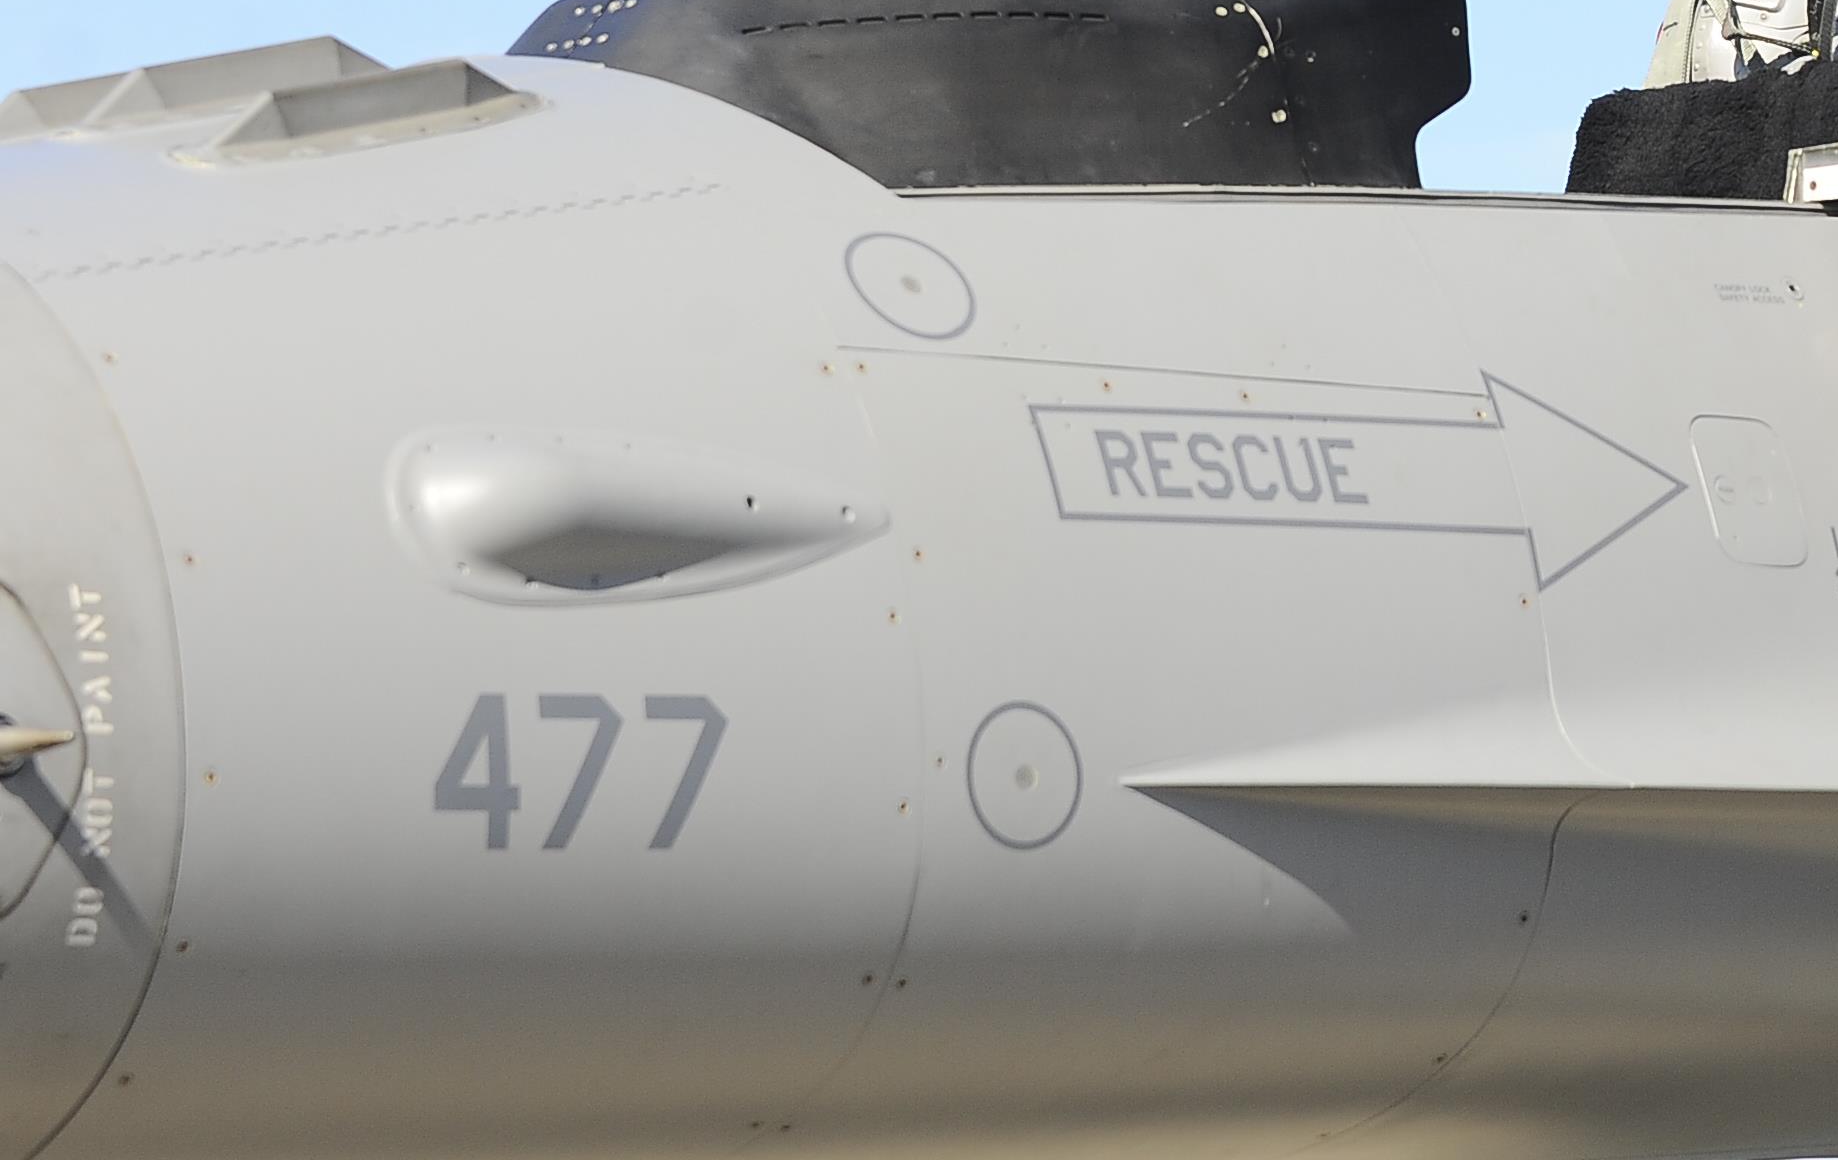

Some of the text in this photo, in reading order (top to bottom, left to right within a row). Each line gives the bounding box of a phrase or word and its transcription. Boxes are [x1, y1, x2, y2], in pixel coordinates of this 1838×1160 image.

[1094, 428, 1370, 505] RESCUE
[65, 582, 114, 947] DO NOT PAINT
[433, 692, 729, 850] 477
